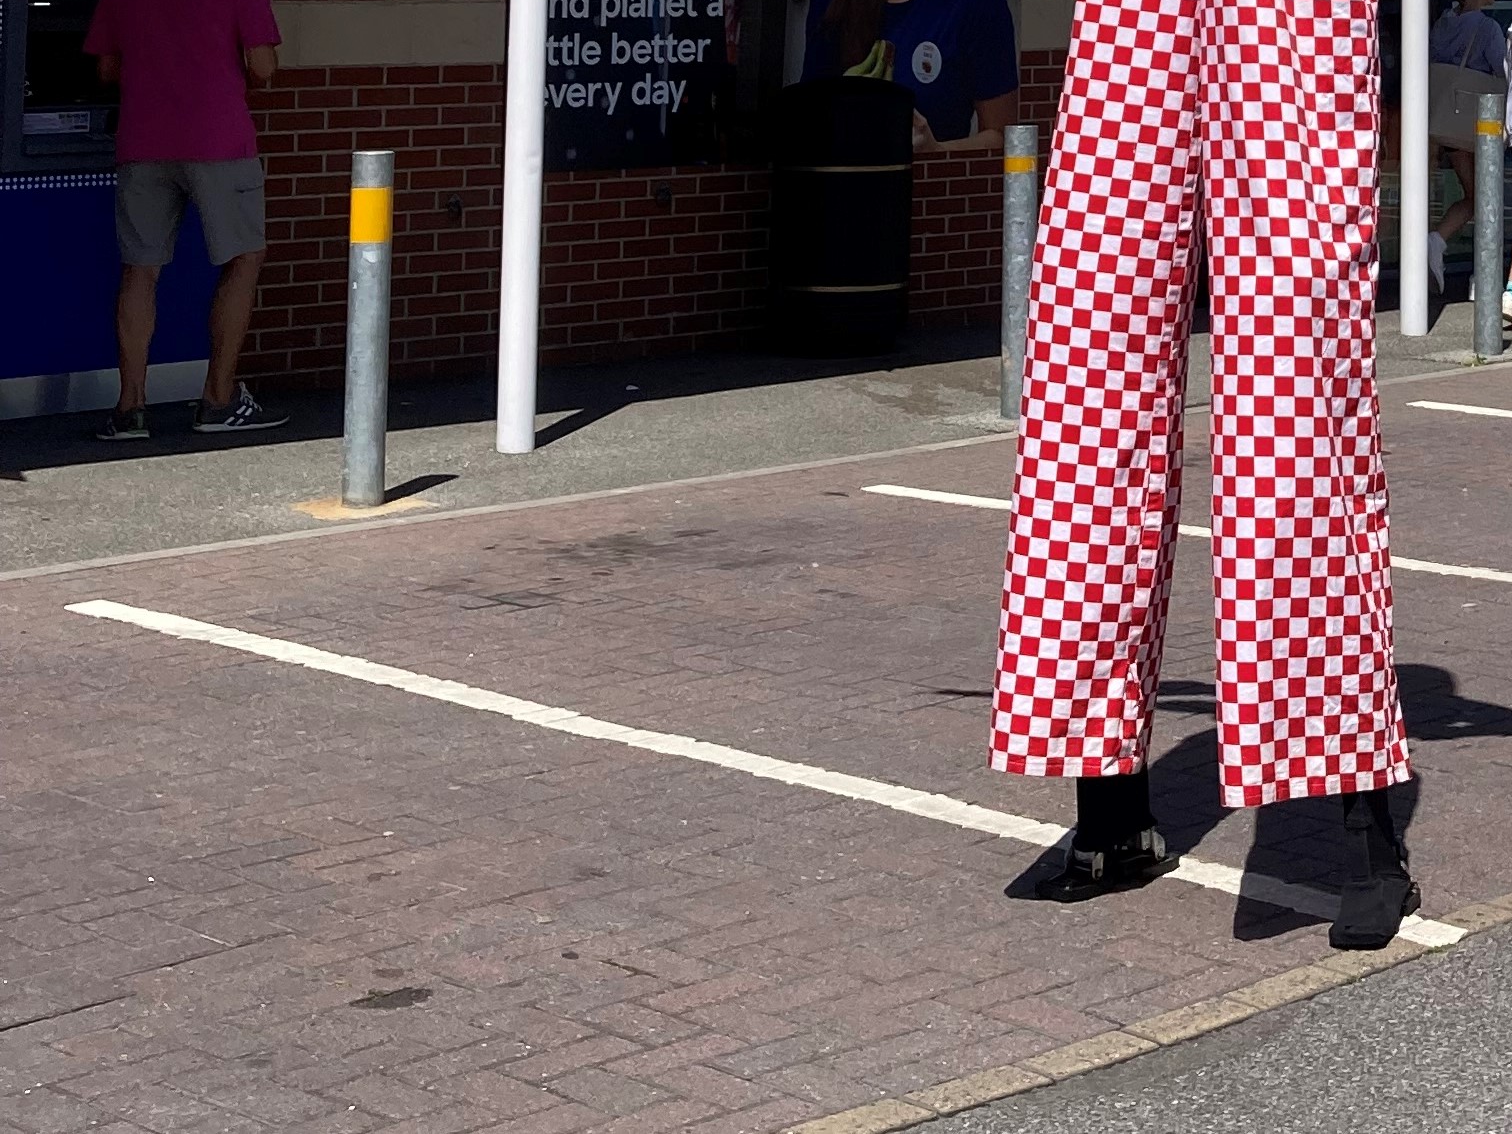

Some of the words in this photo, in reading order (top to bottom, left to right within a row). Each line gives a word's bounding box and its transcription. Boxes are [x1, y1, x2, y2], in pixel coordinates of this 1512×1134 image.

[545, 32, 603, 67] ttle
[610, 31, 712, 66] better
[631, 72, 688, 114] day
